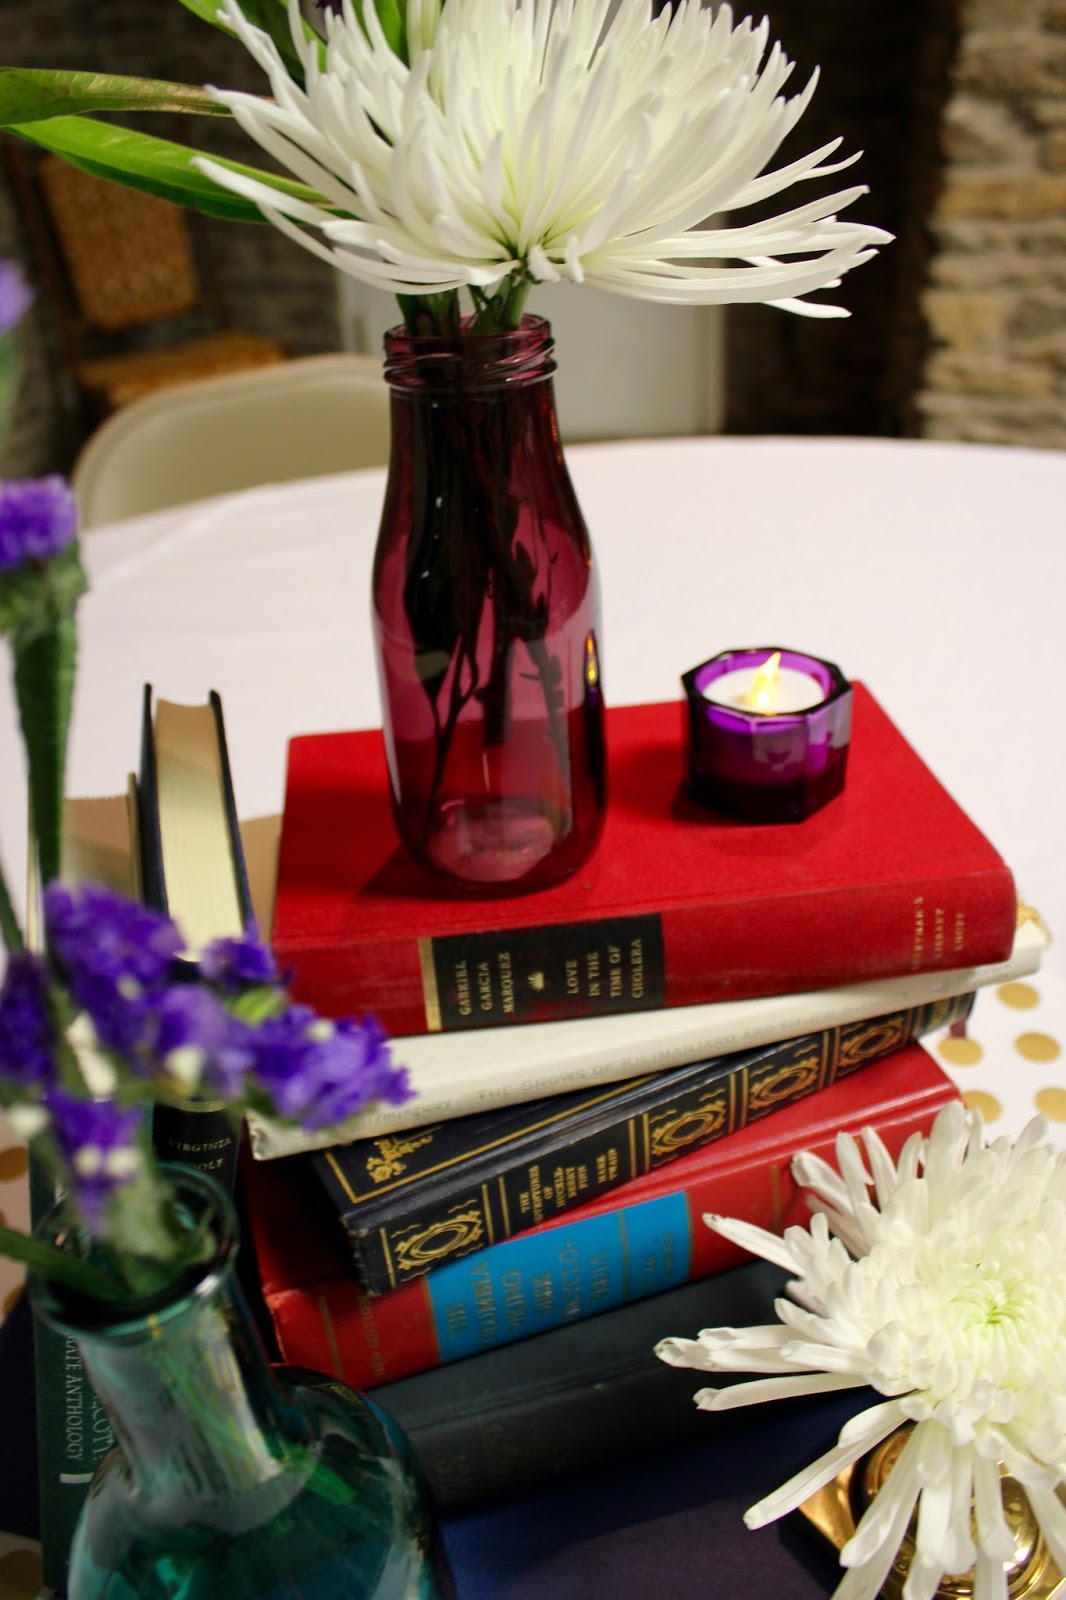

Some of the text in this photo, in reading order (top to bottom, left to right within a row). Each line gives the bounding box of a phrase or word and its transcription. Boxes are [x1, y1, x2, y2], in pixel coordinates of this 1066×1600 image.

[455, 960, 472, 1016] GABRIEL
[478, 962, 493, 1011] GARCIA
[499, 951, 515, 1014] MARQUEZ
[565, 959, 580, 995] LOVE
[587, 951, 601, 997] IN THE
[608, 945, 623, 999] TIME OF
[630, 938, 645, 999] CHOLERA
[475, 1085, 514, 1102] THE
[520, 1065, 586, 1092] SNOWS
[591, 1062, 617, 1077] OF
[621, 1034, 738, 1070] KILIMANJARO
[565, 1167, 577, 1199] BERRY
[577, 1165, 588, 1190] FINN
[597, 1154, 608, 1184] MARK
[607, 1148, 619, 1181] TWAIN
[519, 1191, 531, 1214] THE
[528, 1165, 544, 1224] DVENTURES
[543, 1186, 554, 1200] OF
[65, 1374, 83, 1461] ANTHOLOGY
